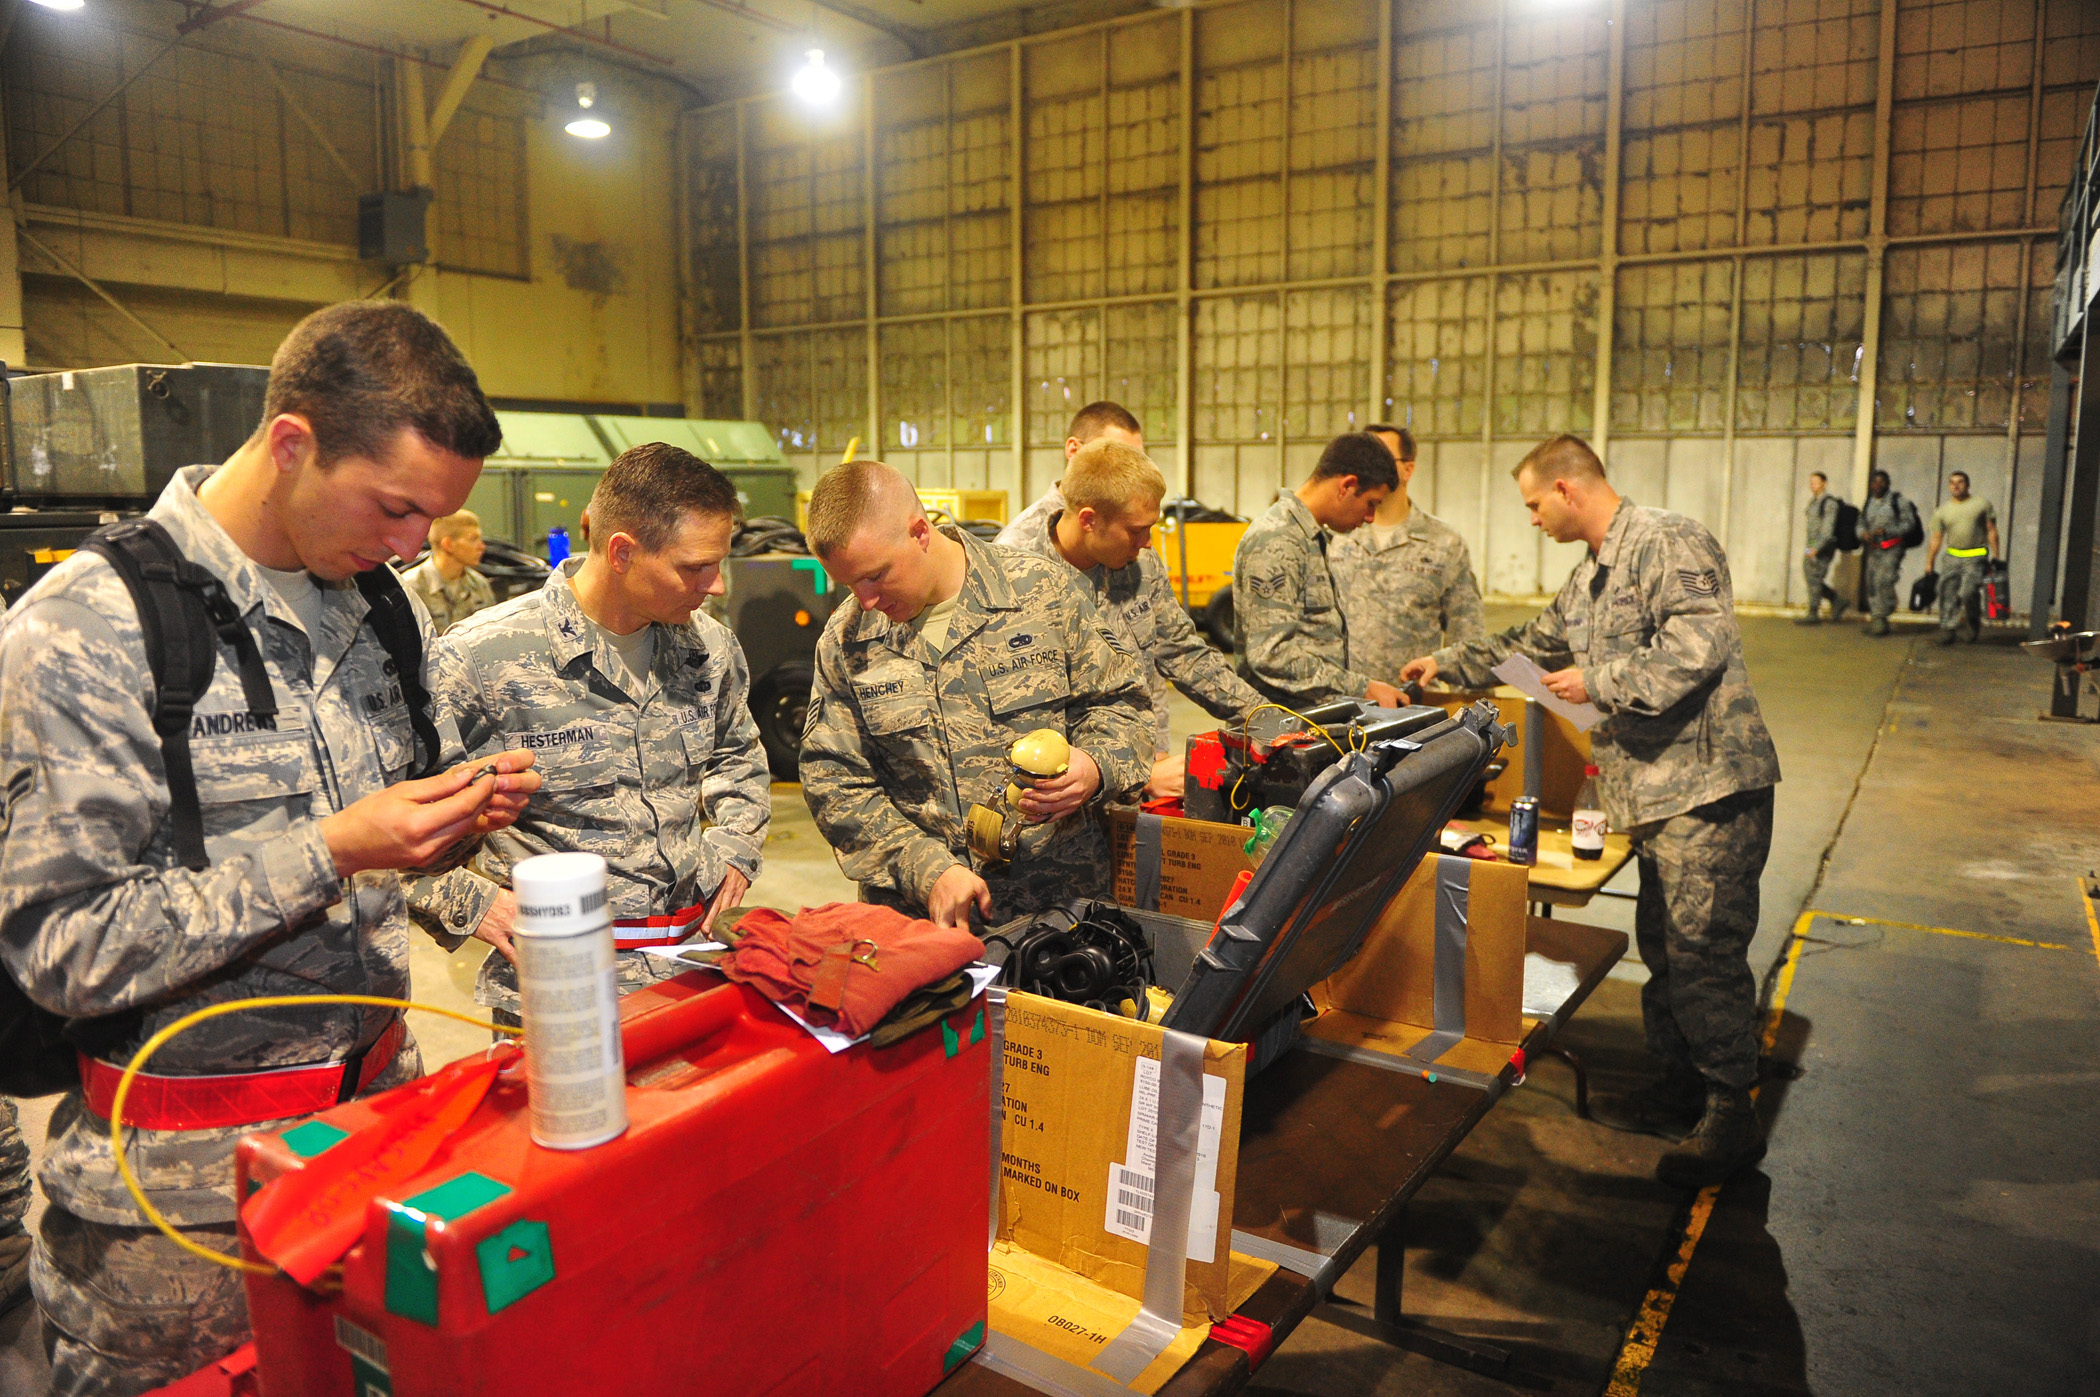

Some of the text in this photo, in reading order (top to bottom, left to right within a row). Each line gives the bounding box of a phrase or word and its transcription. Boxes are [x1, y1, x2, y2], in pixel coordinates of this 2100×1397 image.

[988, 649, 1058, 677] U.S. AIR FORCE
[859, 681, 904, 700] HENCHEY
[680, 709, 697, 724] U.S.
[697, 705, 710, 719] AIR
[521, 727, 594, 748] HESTERMAN
[1167, 849, 1189, 859] GRADE
[1168, 859, 1186, 868] TURB
[1187, 862, 1201, 870] ENG
[1003, 1040, 1043, 1060] GRADE 3
[1003, 1053, 1050, 1077] TURB ENG
[1014, 1114, 1027, 1127] CU
[1030, 1119, 1044, 1132] 1.4
[1001, 1152, 1041, 1174] MONTHS
[1003, 1167, 1080, 1203] MARKED ON BOX
